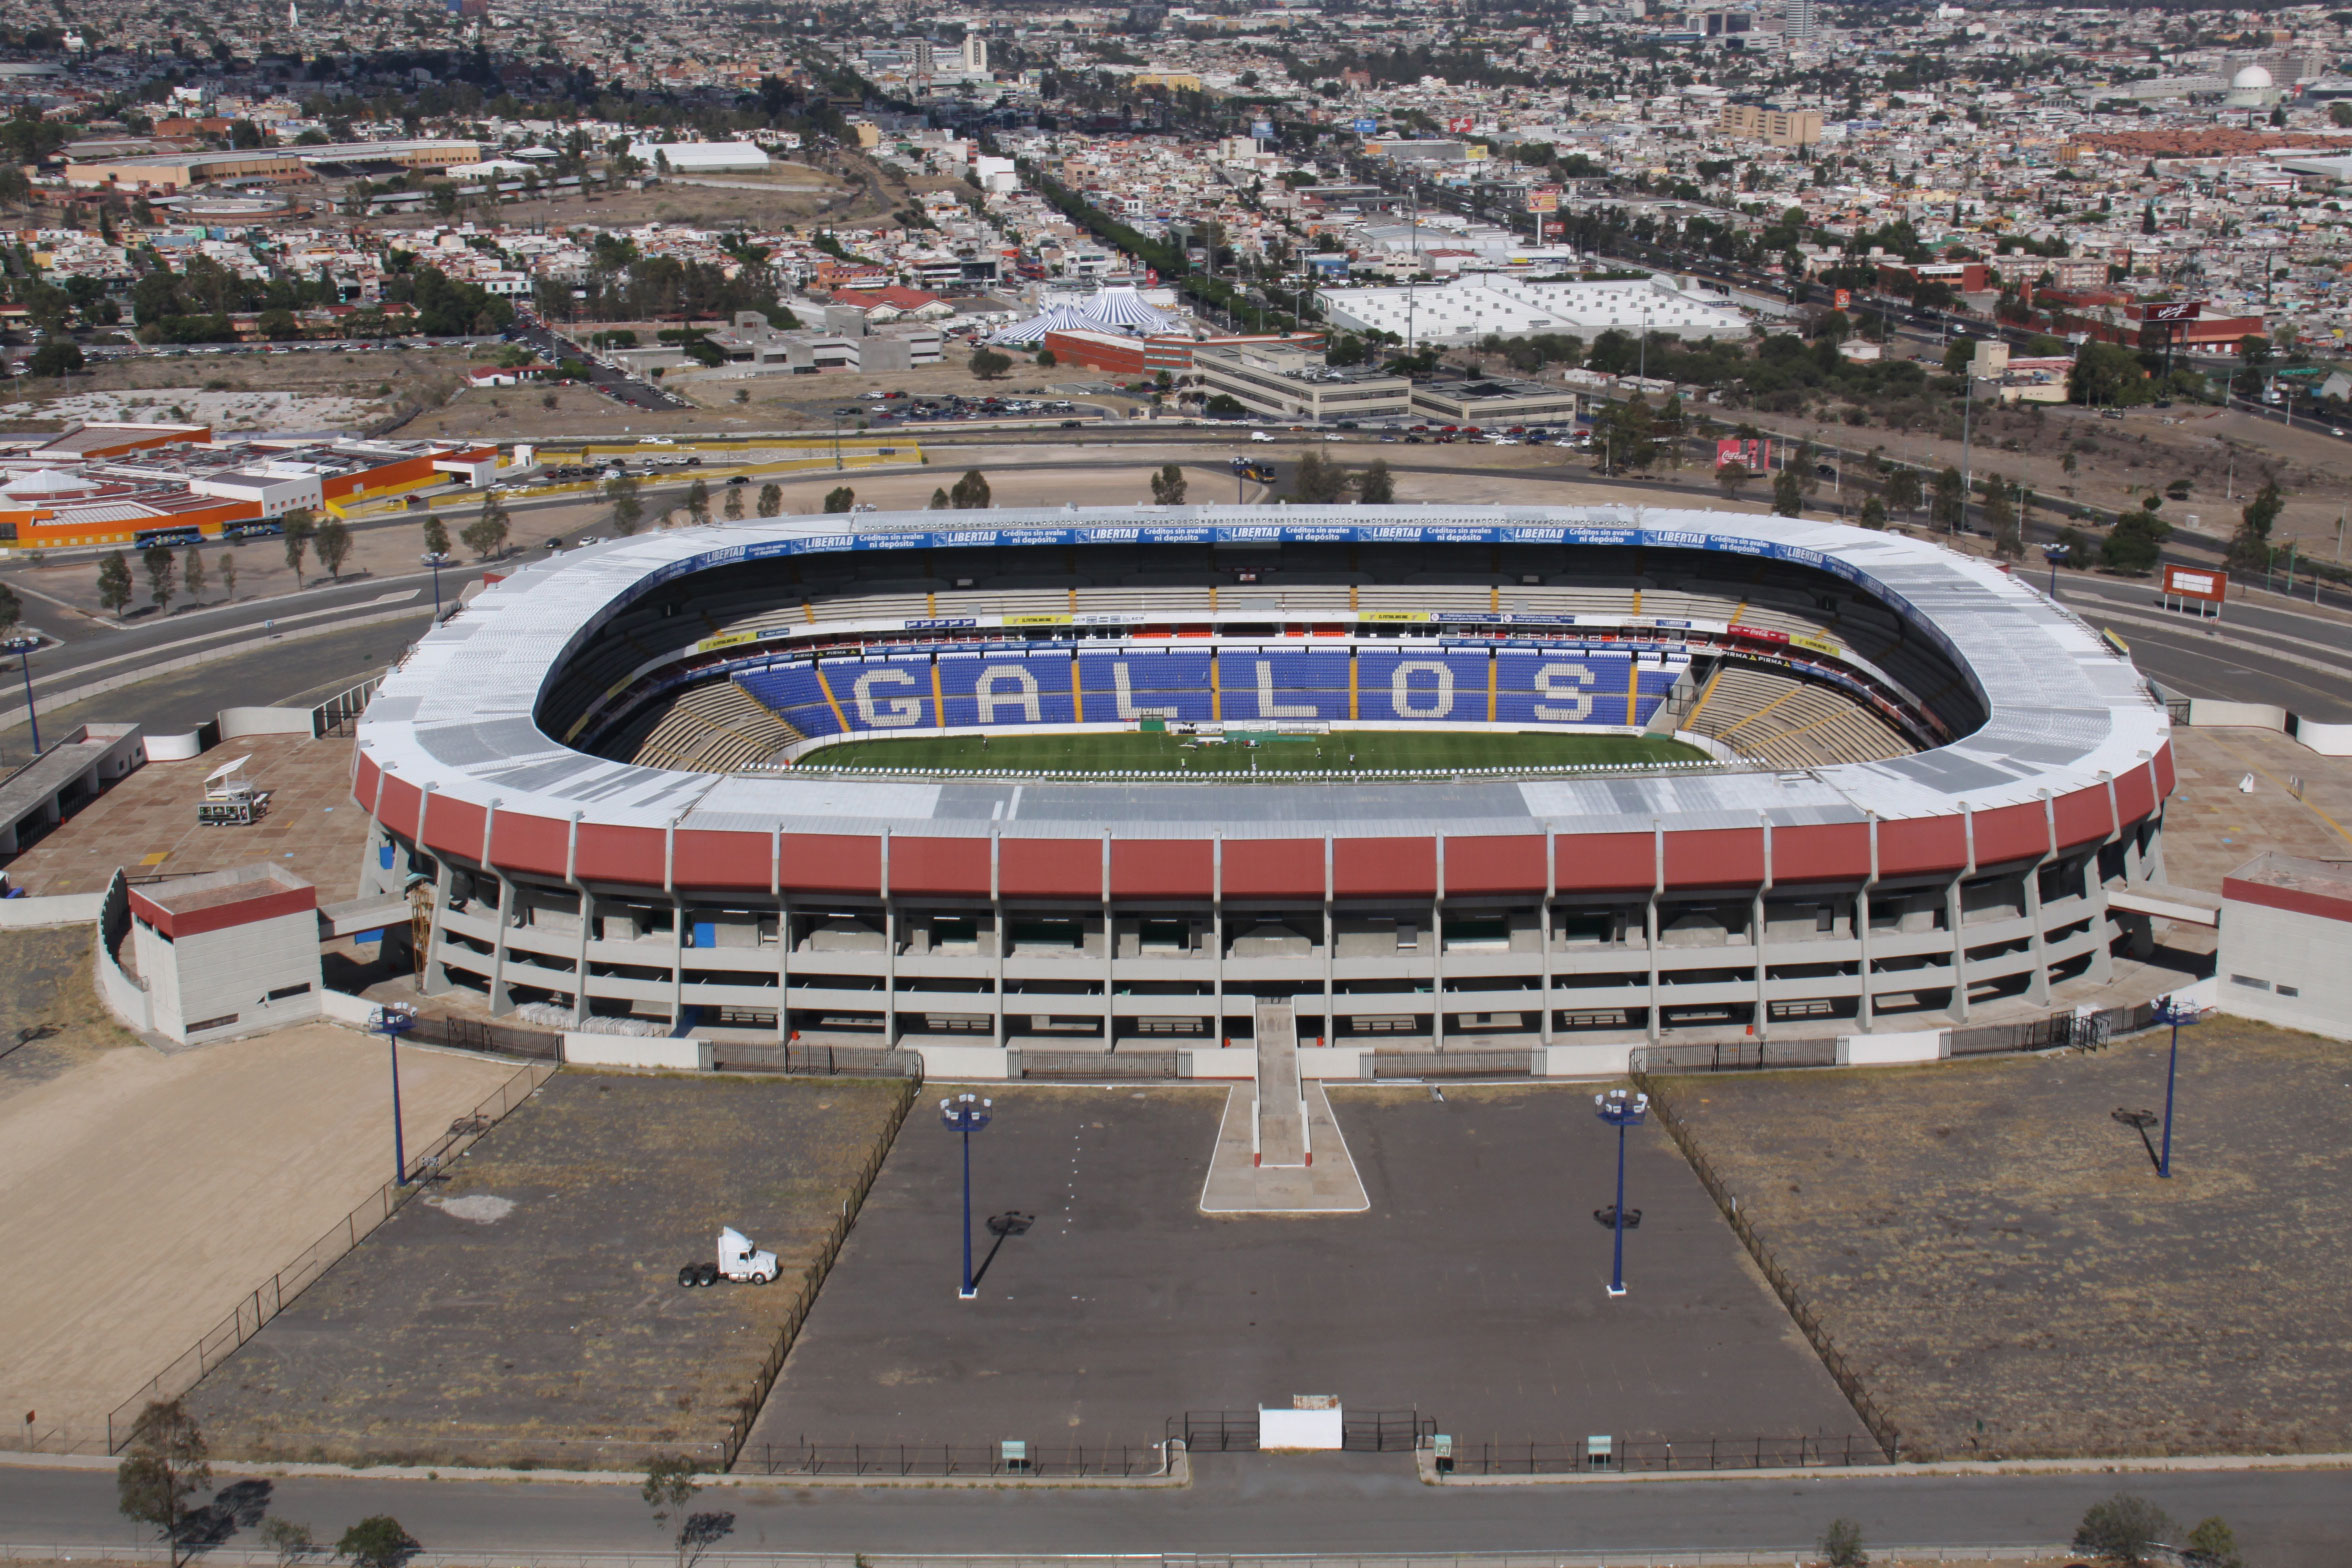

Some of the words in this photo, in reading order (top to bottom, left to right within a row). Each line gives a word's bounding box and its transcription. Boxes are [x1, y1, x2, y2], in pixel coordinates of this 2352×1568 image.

[948, 532, 996, 542] LIBERTAD
[1090, 528, 1138, 539] LIBERTAD
[1232, 528, 1280, 538] LIBERTAD
[1374, 528, 1421, 538] LIBERTAD
[1515, 528, 1564, 538] LIBERTAD
[1658, 532, 1706, 544] LIBERTAD
[806, 536, 854, 548] LIBERTAD
[706, 546, 746, 562] LIBERTAD
[1787, 546, 1824, 564] LIBERTAD
[1722, 651, 1748, 660] PIRMA
[1758, 656, 1782, 665] PIRMA
[853, 660, 1594, 727] GALLOS
